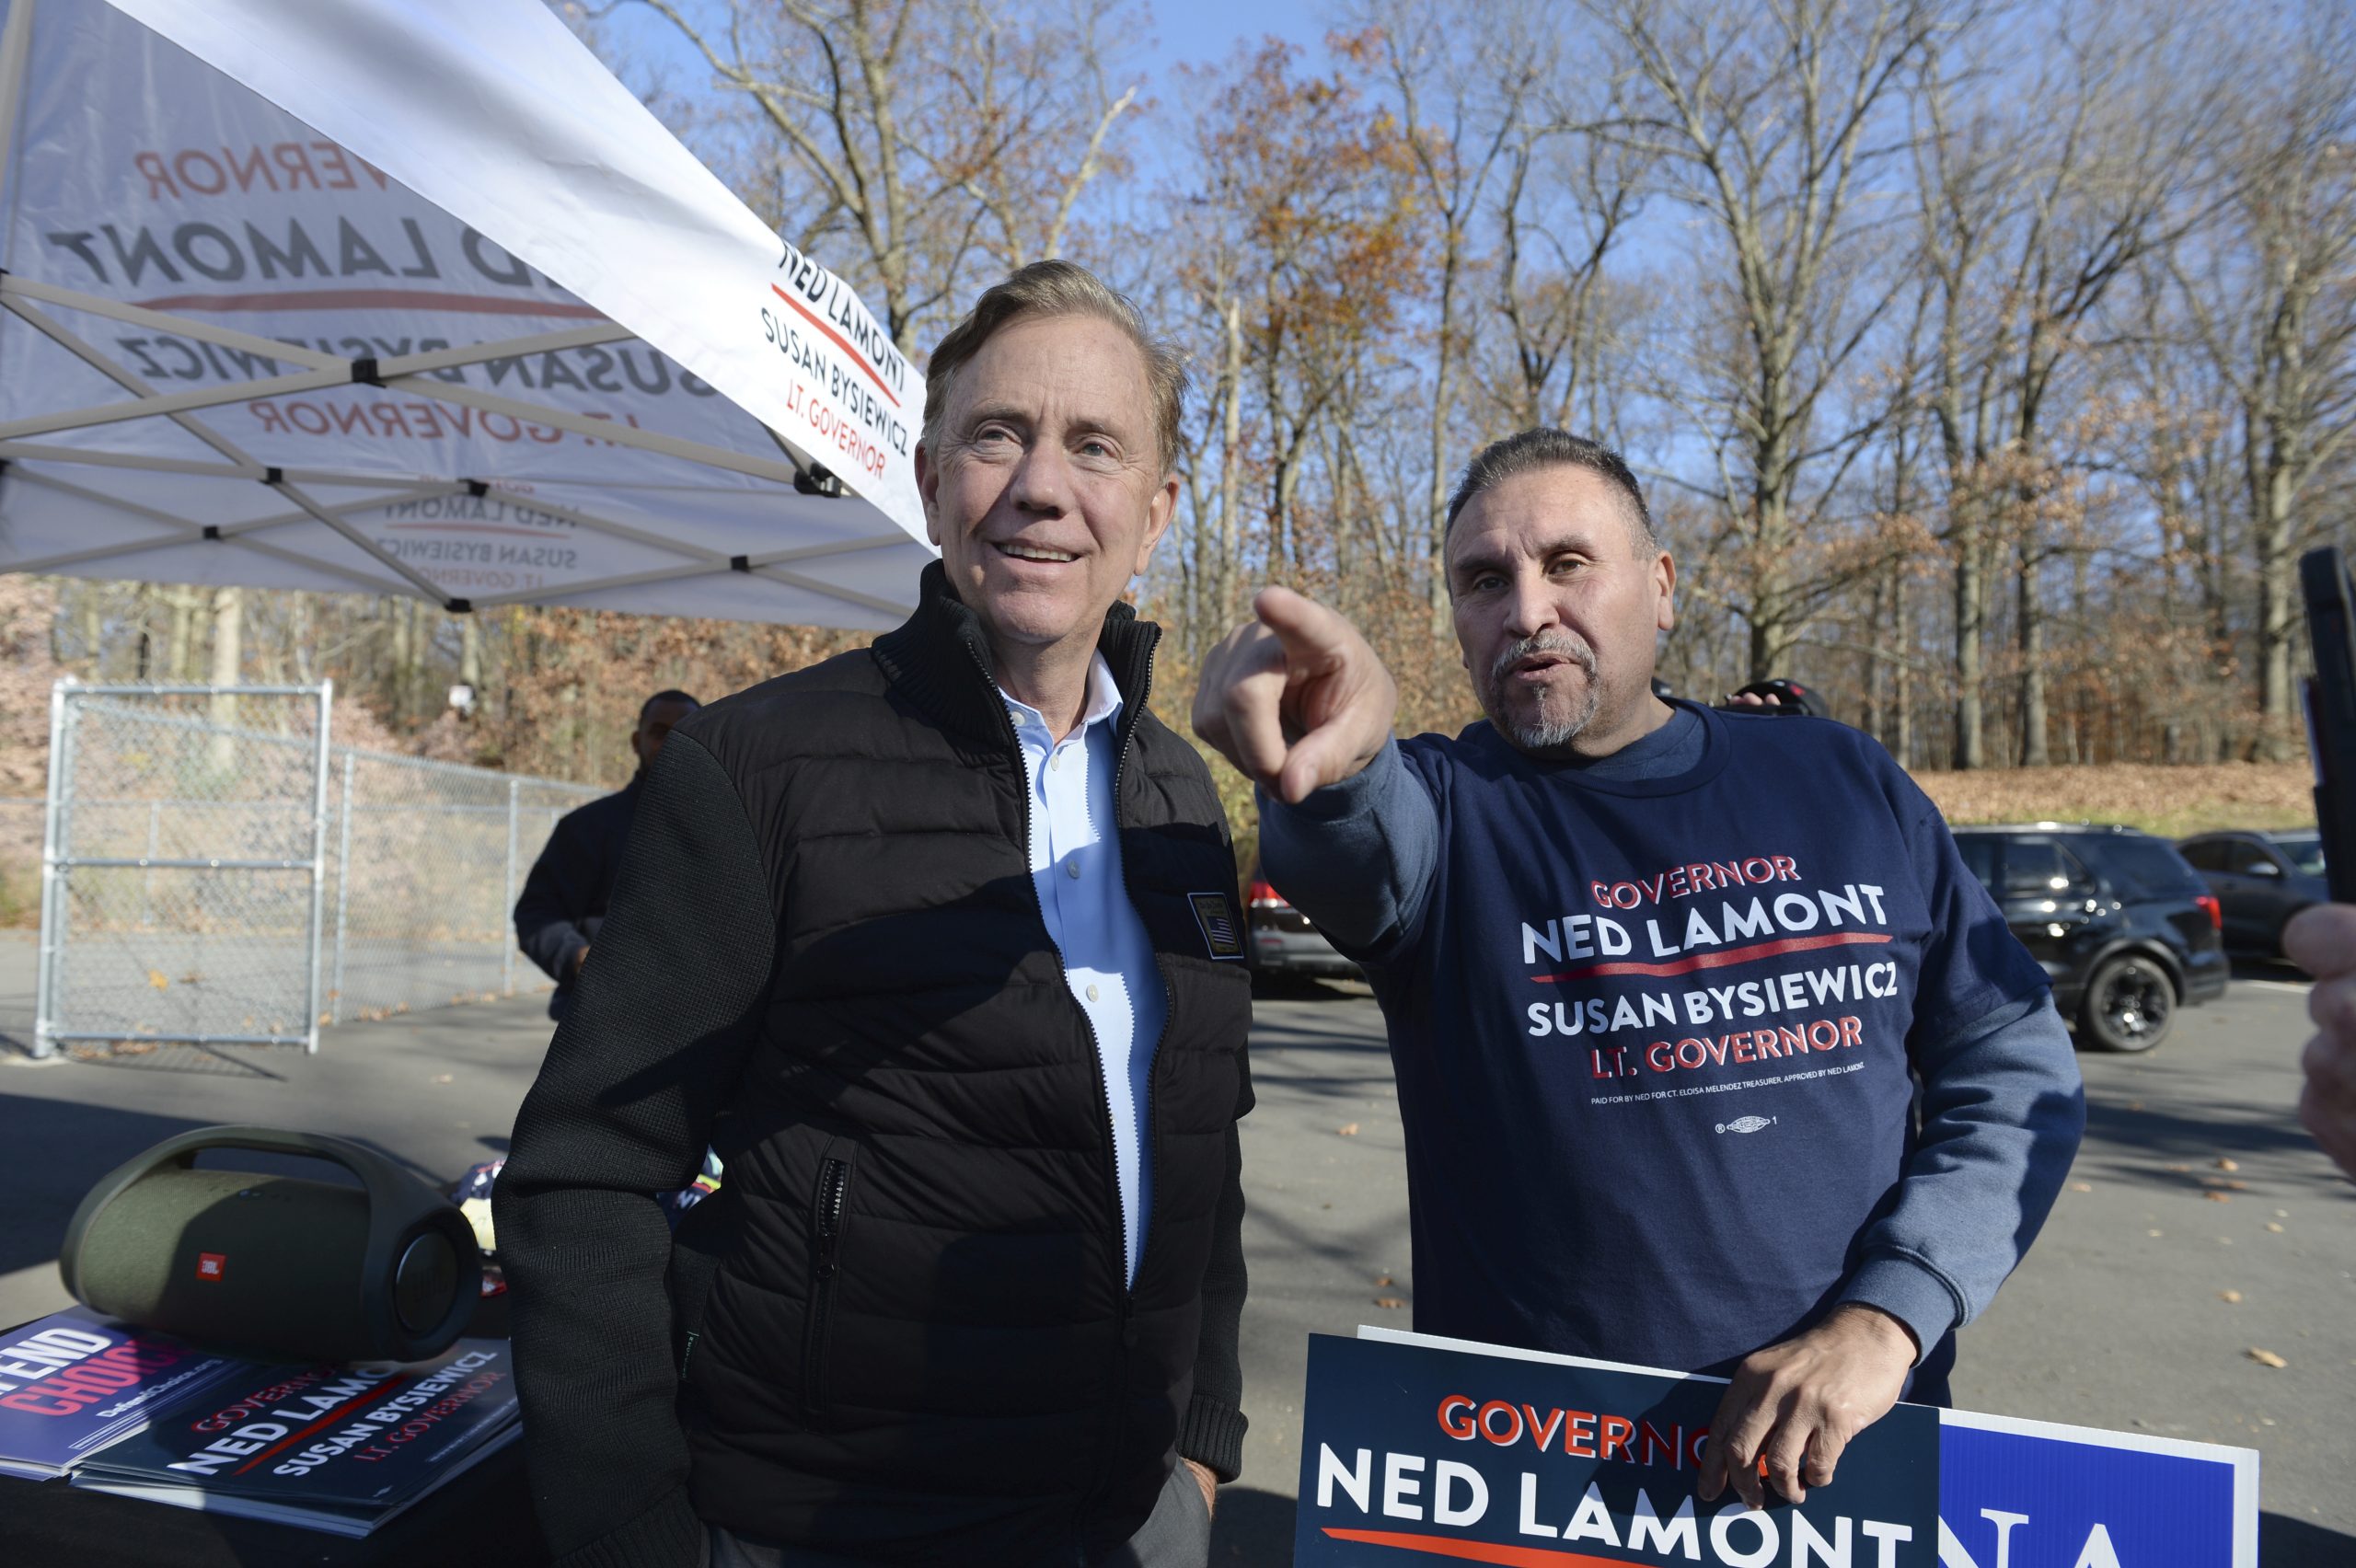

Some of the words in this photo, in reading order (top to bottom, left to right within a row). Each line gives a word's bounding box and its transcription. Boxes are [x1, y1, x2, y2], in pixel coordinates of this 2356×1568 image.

[780, 241, 827, 303] NED
[828, 282, 906, 392] LAMONT
[761, 307, 826, 386] SUSAN
[832, 364, 907, 456] BYSIEWICZ
[787, 379, 804, 418] LT.
[810, 398, 886, 480] GOVERNOR
[1522, 914, 1632, 964] NED
[1646, 883, 1888, 958] LAMONT
[1591, 855, 1801, 910] GOVERNOR
[1528, 992, 1677, 1037] SUSAN
[1683, 962, 1898, 1025] BYSIEWICZ
[1591, 1046, 1637, 1079] LT.
[1646, 1016, 1863, 1073] GOVERNOR
[1591, 1097, 1608, 1105] PAID
[1609, 1095, 1623, 1103] FOR
[1624, 1094, 1634, 1102] BY
[1634, 1093, 1650, 1101] NED
[1667, 1090, 1679, 1098] CT.
[1680, 1086, 1704, 1096] ELOISA
[1705, 1081, 1741, 1093] MELENDEZ
[1743, 1077, 1783, 1089] TREASURER.
[1784, 1071, 1818, 1083] APPROVED
[1818, 1069, 1827, 1078] BY
[1827, 1066, 1842, 1076] NED
[202, 1260, 220, 1275] JBL
[167, 1423, 289, 1476] NED
[271, 1361, 399, 1421] LAMO
[272, 1423, 384, 1477] SUSAN
[364, 1351, 498, 1423] BYSIEWICZ
[353, 1445, 399, 1462] LT.
[386, 1371, 506, 1444] GOVERNOR
[1438, 1394, 1769, 1478] GOVERN
[1317, 1442, 1489, 1528] NED
[1519, 1471, 1913, 1568] LAMONT
